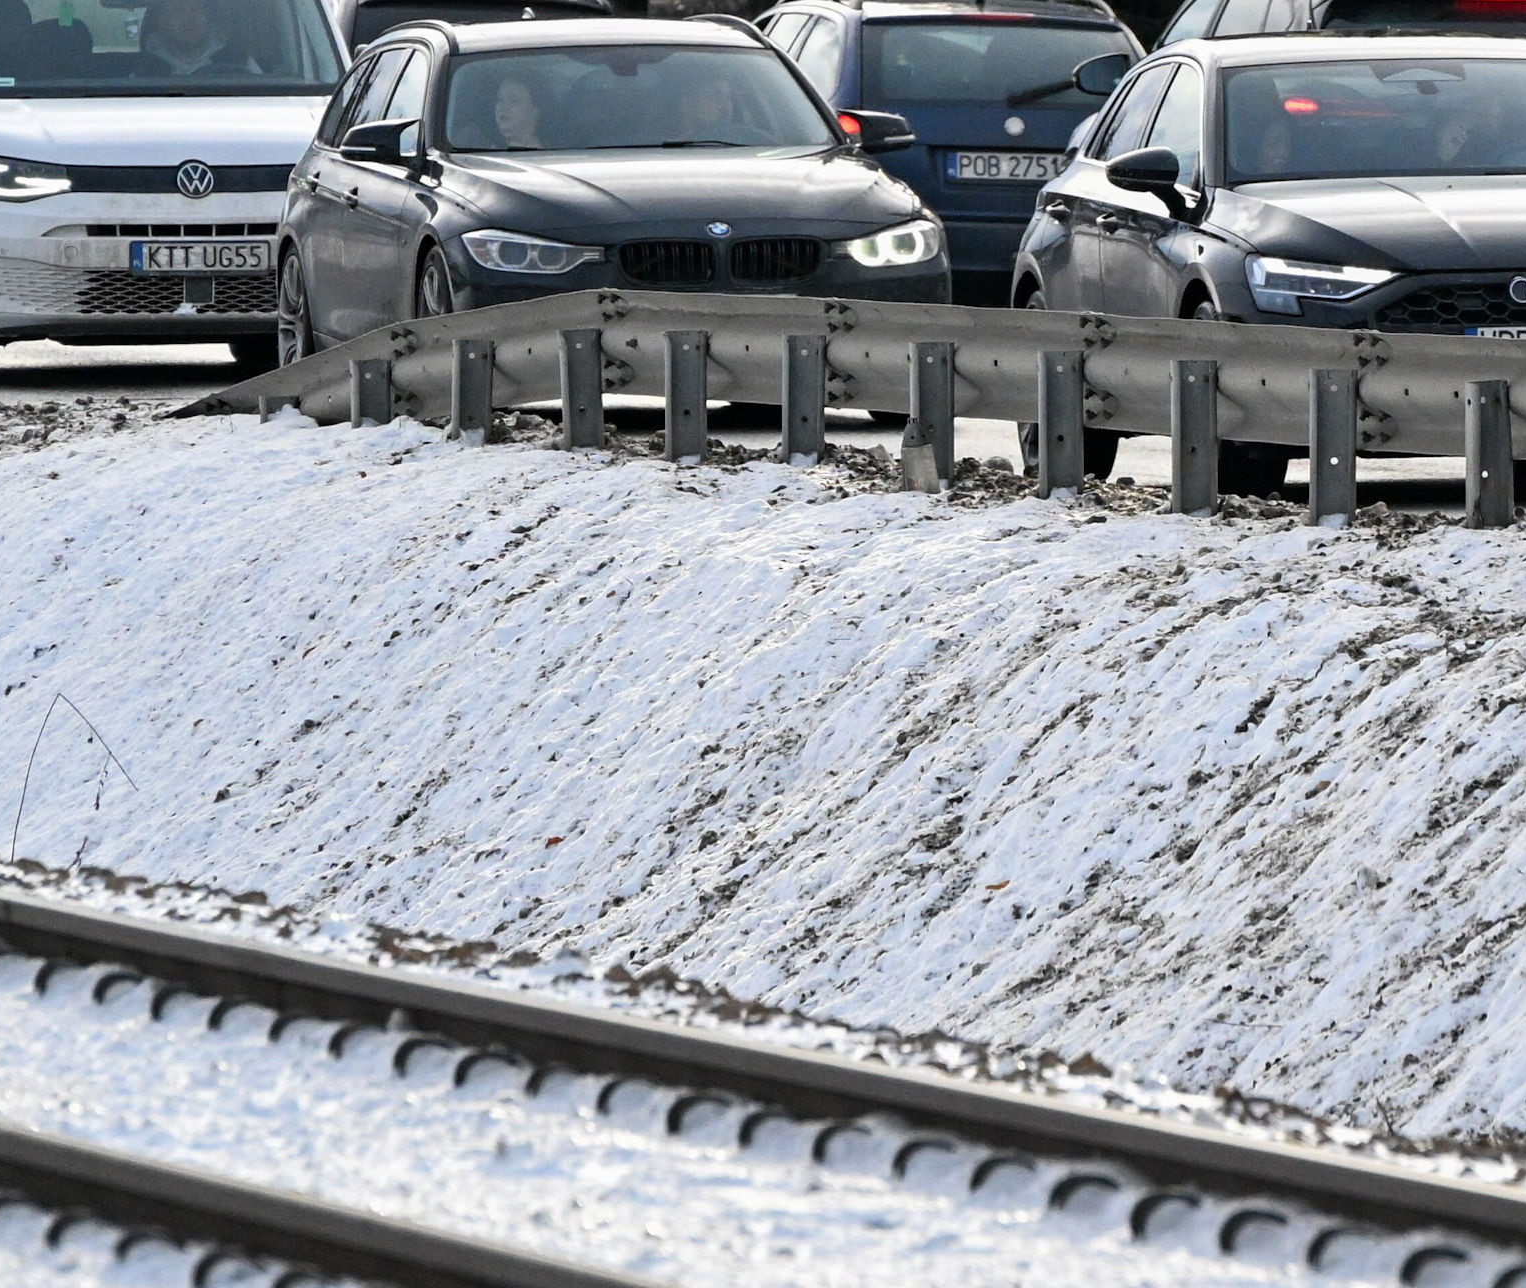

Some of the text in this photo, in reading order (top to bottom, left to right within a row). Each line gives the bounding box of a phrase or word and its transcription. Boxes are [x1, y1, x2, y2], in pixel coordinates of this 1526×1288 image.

[959, 155, 1001, 177] POB
[148, 245, 194, 268] KTT
[203, 245, 261, 268] UG55
